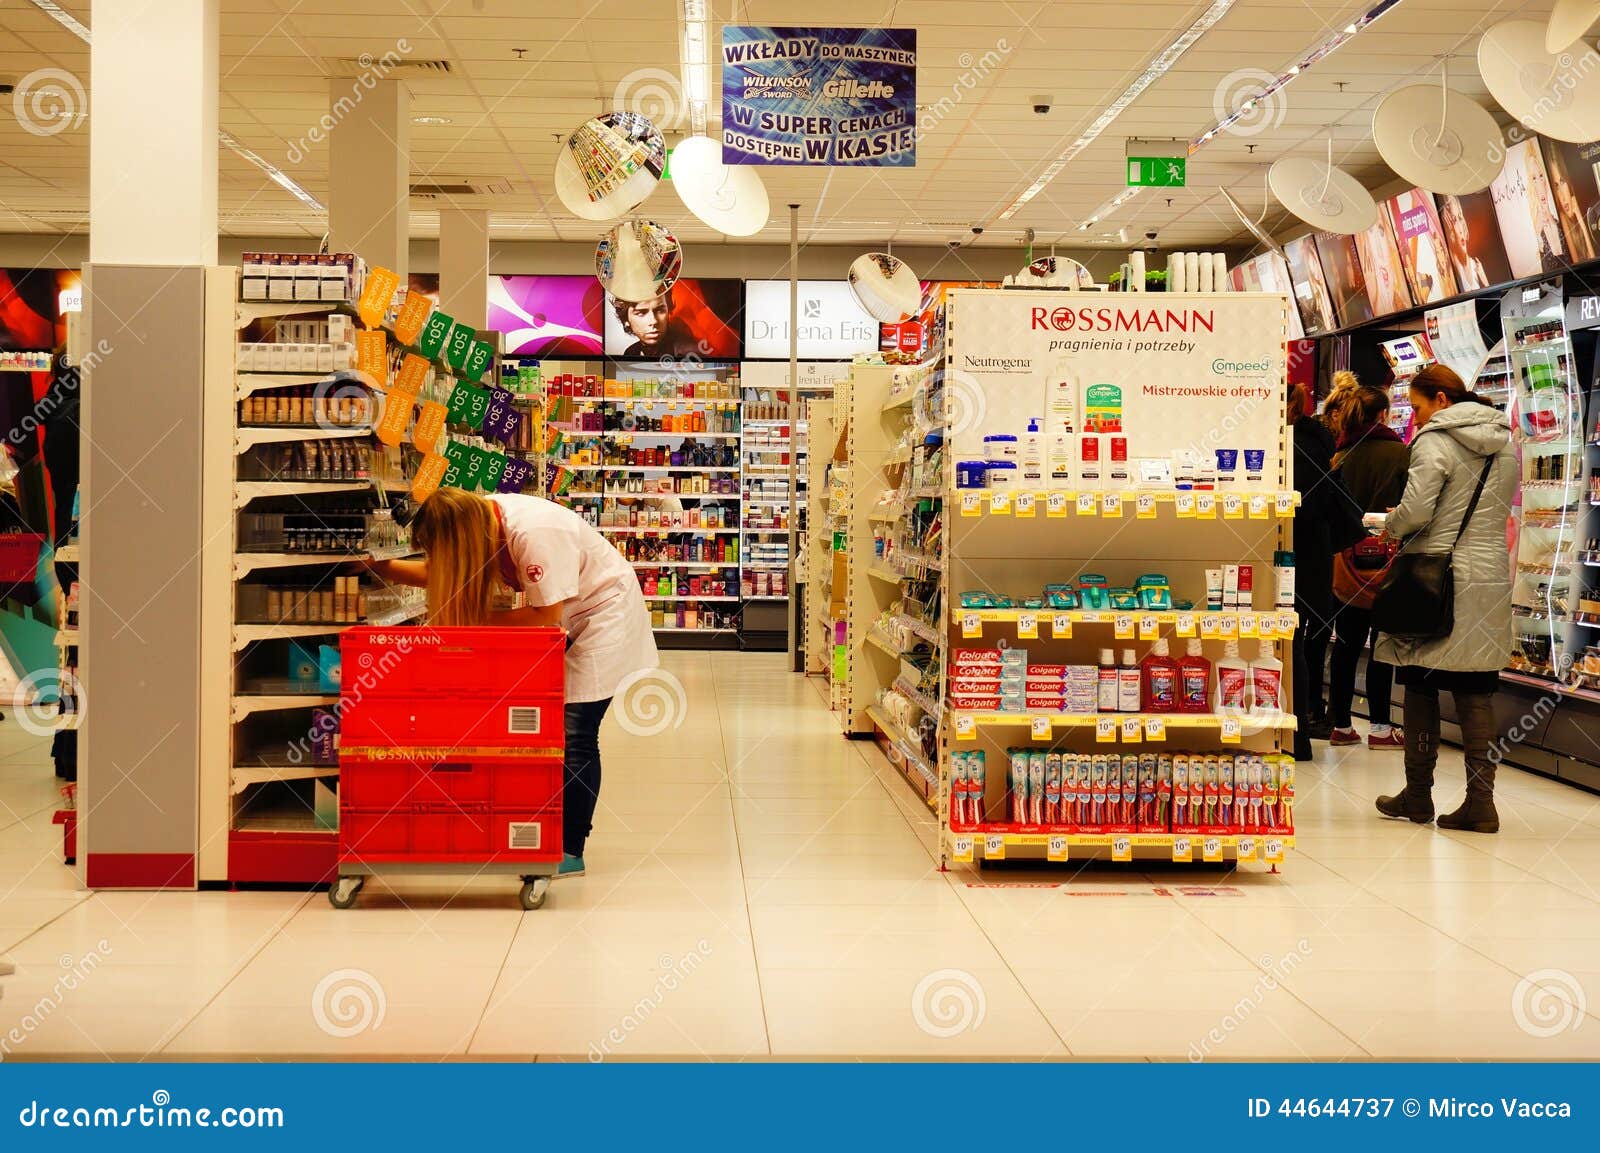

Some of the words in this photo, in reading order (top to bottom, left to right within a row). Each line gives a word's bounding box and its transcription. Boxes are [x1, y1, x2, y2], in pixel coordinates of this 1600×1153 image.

[725, 39, 816, 63] WKŁADY
[822, 46, 838, 57] DO
[844, 47, 914, 64] MASZYNEK
[743, 76, 812, 88] WILKINSON
[823, 80, 894, 98] Gillette
[762, 91, 792, 99] SWORD
[734, 105, 754, 125] W
[761, 112, 833, 135] SUPER
[838, 110, 904, 133] CENACH
[725, 132, 800, 158] DOSTĘPNE
[805, 140, 829, 159] W
[837, 128, 912, 159] KASIE
[1031, 307, 1214, 333] ROSSMANN
[428, 319, 446, 346] 50+
[752, 320, 778, 340] Dr
[784, 321, 832, 341] Iena
[840, 321, 873, 341] Eris
[453, 331, 468, 356] 50+
[1049, 338, 1123, 353] pragnienia
[1127, 338, 1133, 351] i
[1135, 338, 1196, 354] potrzeby
[472, 348, 487, 371] 50+
[965, 355, 1032, 371] Neutrogena
[1212, 358, 1269, 375] Compeed
[452, 387, 469, 412] 50+
[1142, 385, 1227, 397] Mistrzowskie
[1231, 385, 1271, 400] oferty
[472, 394, 484, 417] 50+
[489, 405, 503, 427] 30+
[503, 414, 518, 434] 30+
[467, 453, 482, 478] 50+
[487, 457, 502, 481] 50+
[501, 462, 517, 484] 30+
[369, 635, 442, 645] ROSSMANN
[958, 667, 997, 676] Colgate
[1029, 666, 1062, 675] Colgate
[957, 683, 996, 692] Colgate
[1029, 683, 1061, 691] Colgate
[958, 698, 997, 708] Colgate
[1029, 699, 1061, 707] Colgate
[368, 751, 448, 761] ROSSMANN
